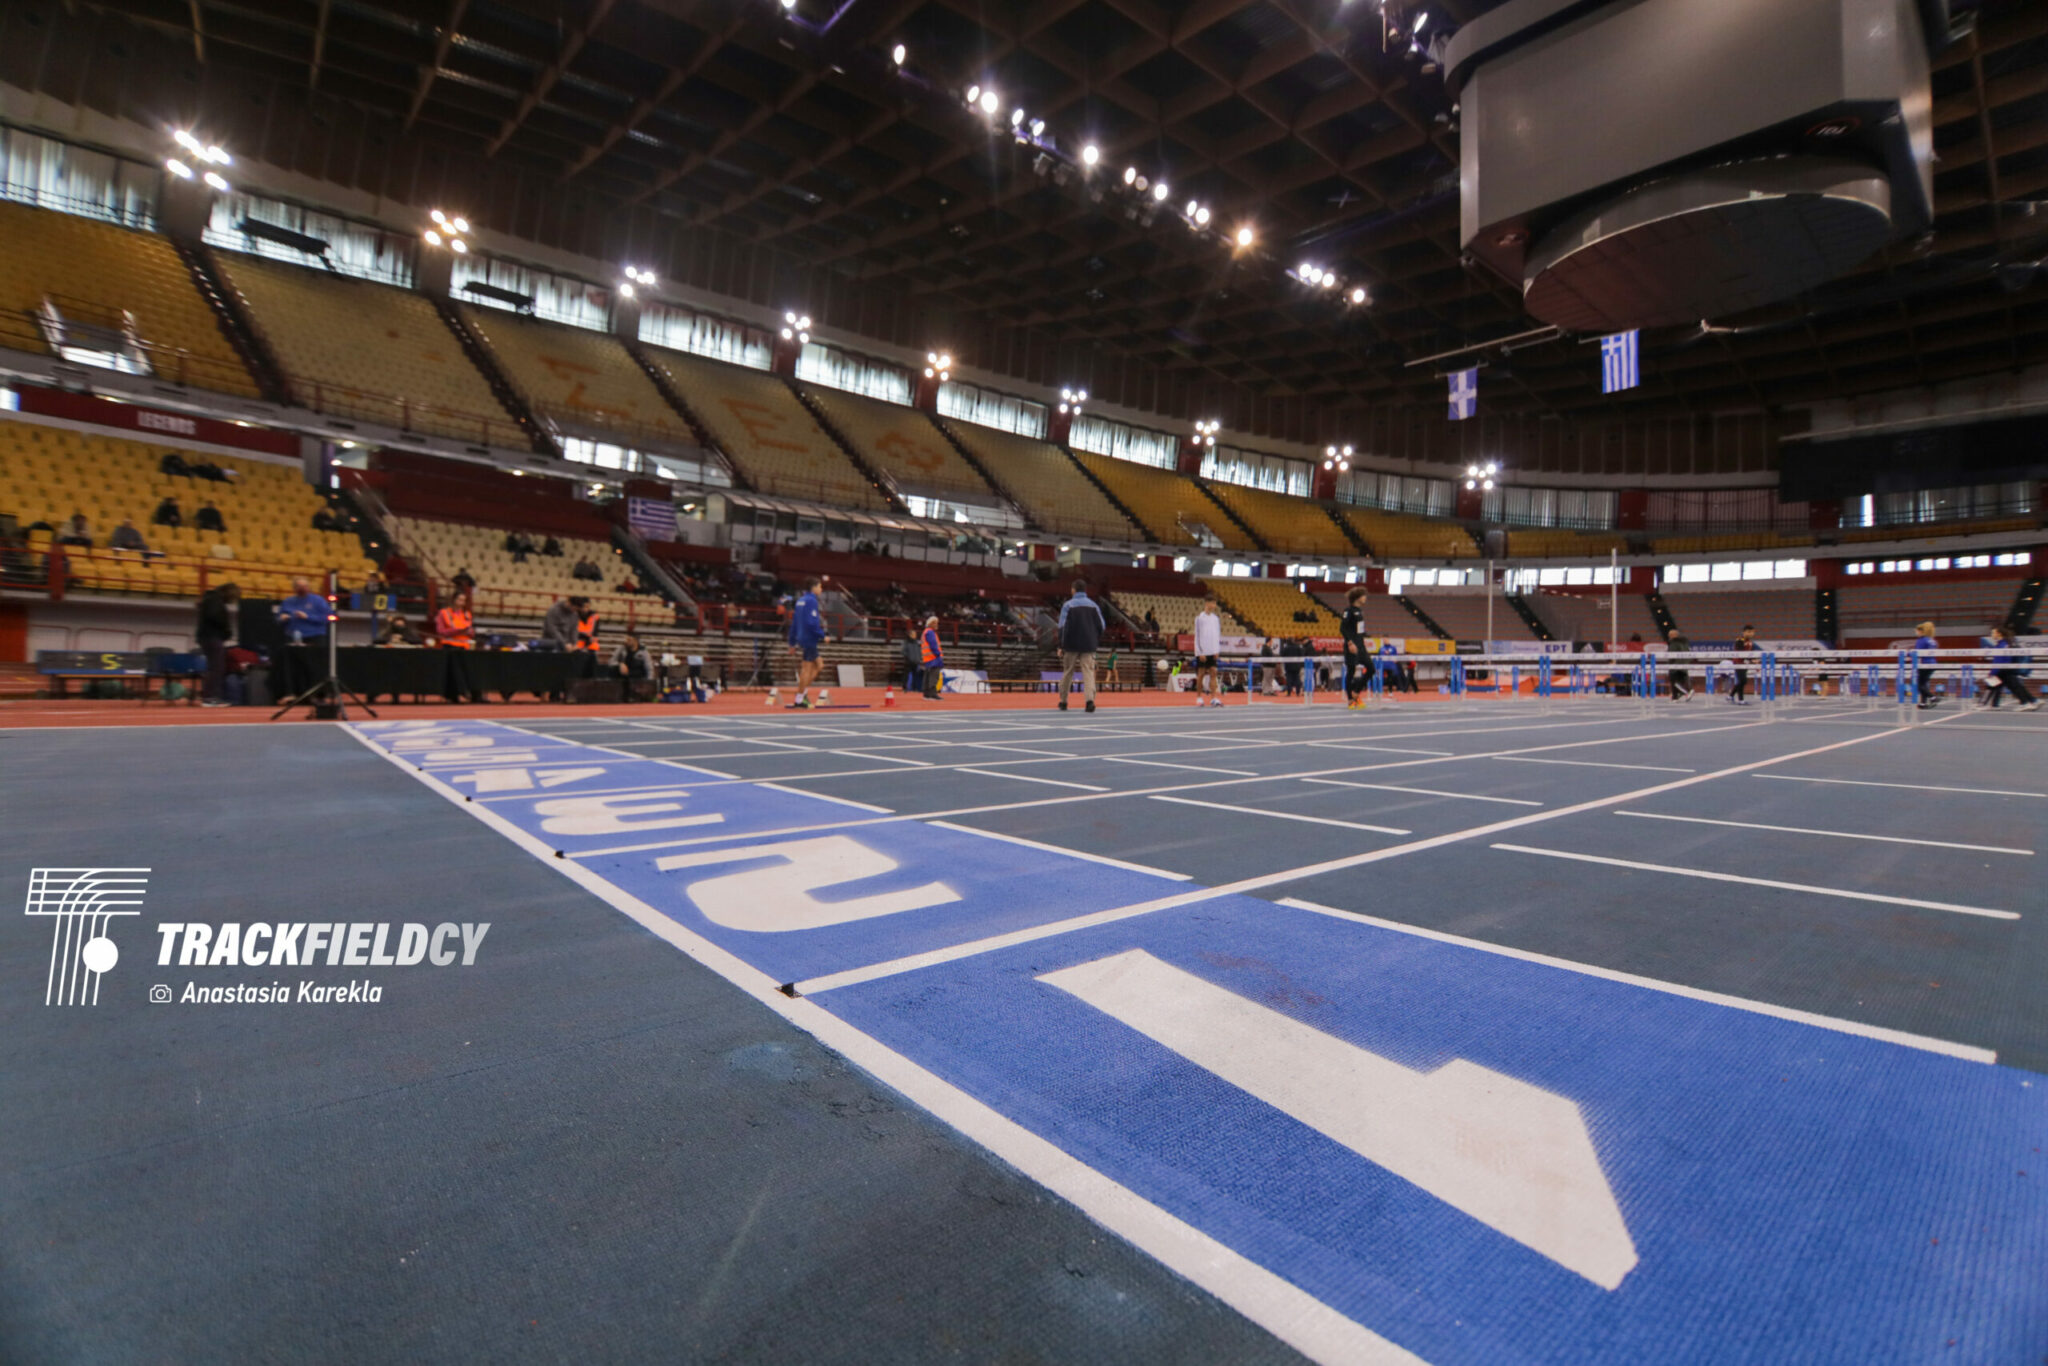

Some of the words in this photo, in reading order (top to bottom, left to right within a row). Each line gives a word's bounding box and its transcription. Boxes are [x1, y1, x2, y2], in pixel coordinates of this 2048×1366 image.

[452, 767, 608, 793] 4
[533, 790, 725, 836] 3
[655, 834, 964, 932] 2
[1033, 948, 1640, 1292] 1
